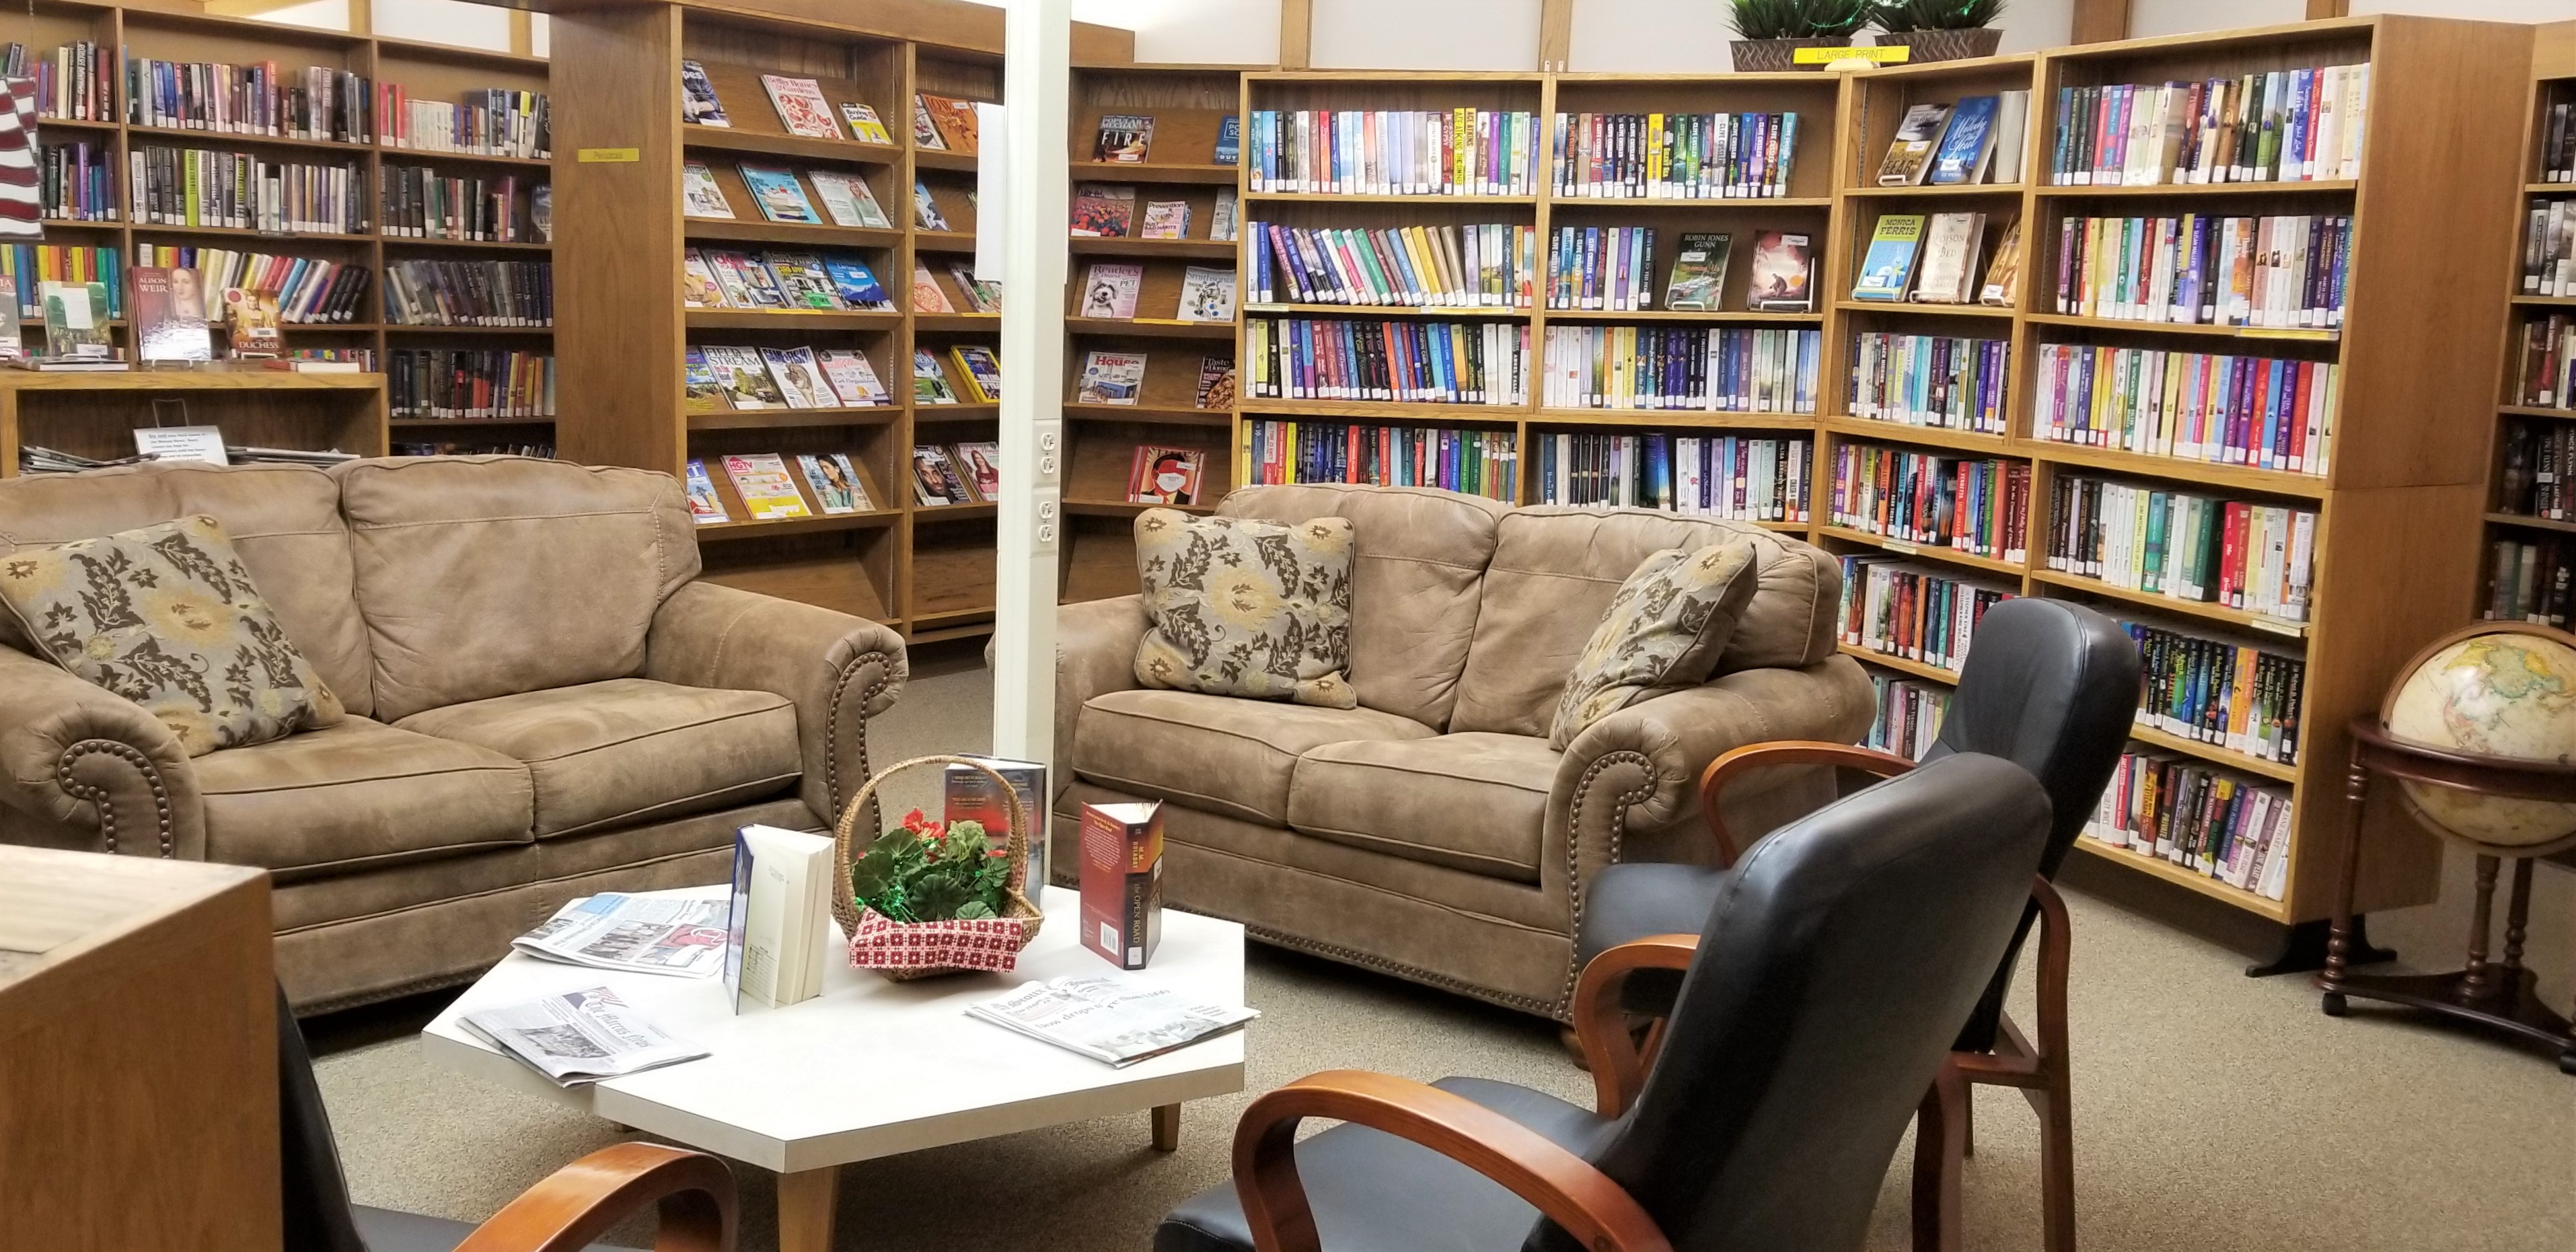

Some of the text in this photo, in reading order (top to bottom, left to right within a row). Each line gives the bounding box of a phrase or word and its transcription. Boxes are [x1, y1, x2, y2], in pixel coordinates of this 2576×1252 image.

[1817, 49, 1885, 59] LARGE PRINT
[1455, 112, 1463, 124] ACE
[1101, 132, 1146, 147] FIRE
[1455, 126, 1463, 149] ATKINS
[1884, 159, 1914, 175] FEAR
[1880, 226, 1916, 235] FERRIS
[1938, 247, 1957, 258] BED
[139, 284, 168, 293] WEIR
[1120, 280, 1137, 288] PET
[239, 341, 279, 349] DUCHESS
[709, 357, 761, 366] STREAM
[1206, 358, 1230, 366] Taste
[729, 462, 753, 470] HGTV
[2214, 655, 2222, 672] Robert
[2102, 793, 2111, 825] GUILTY WIVES
[2204, 799, 2215, 827] WANDERERS
[2160, 813, 2170, 839] PRIVATE
[2273, 813, 2289, 849] JANE PEART
[1133, 920, 1141, 945] ROAD
